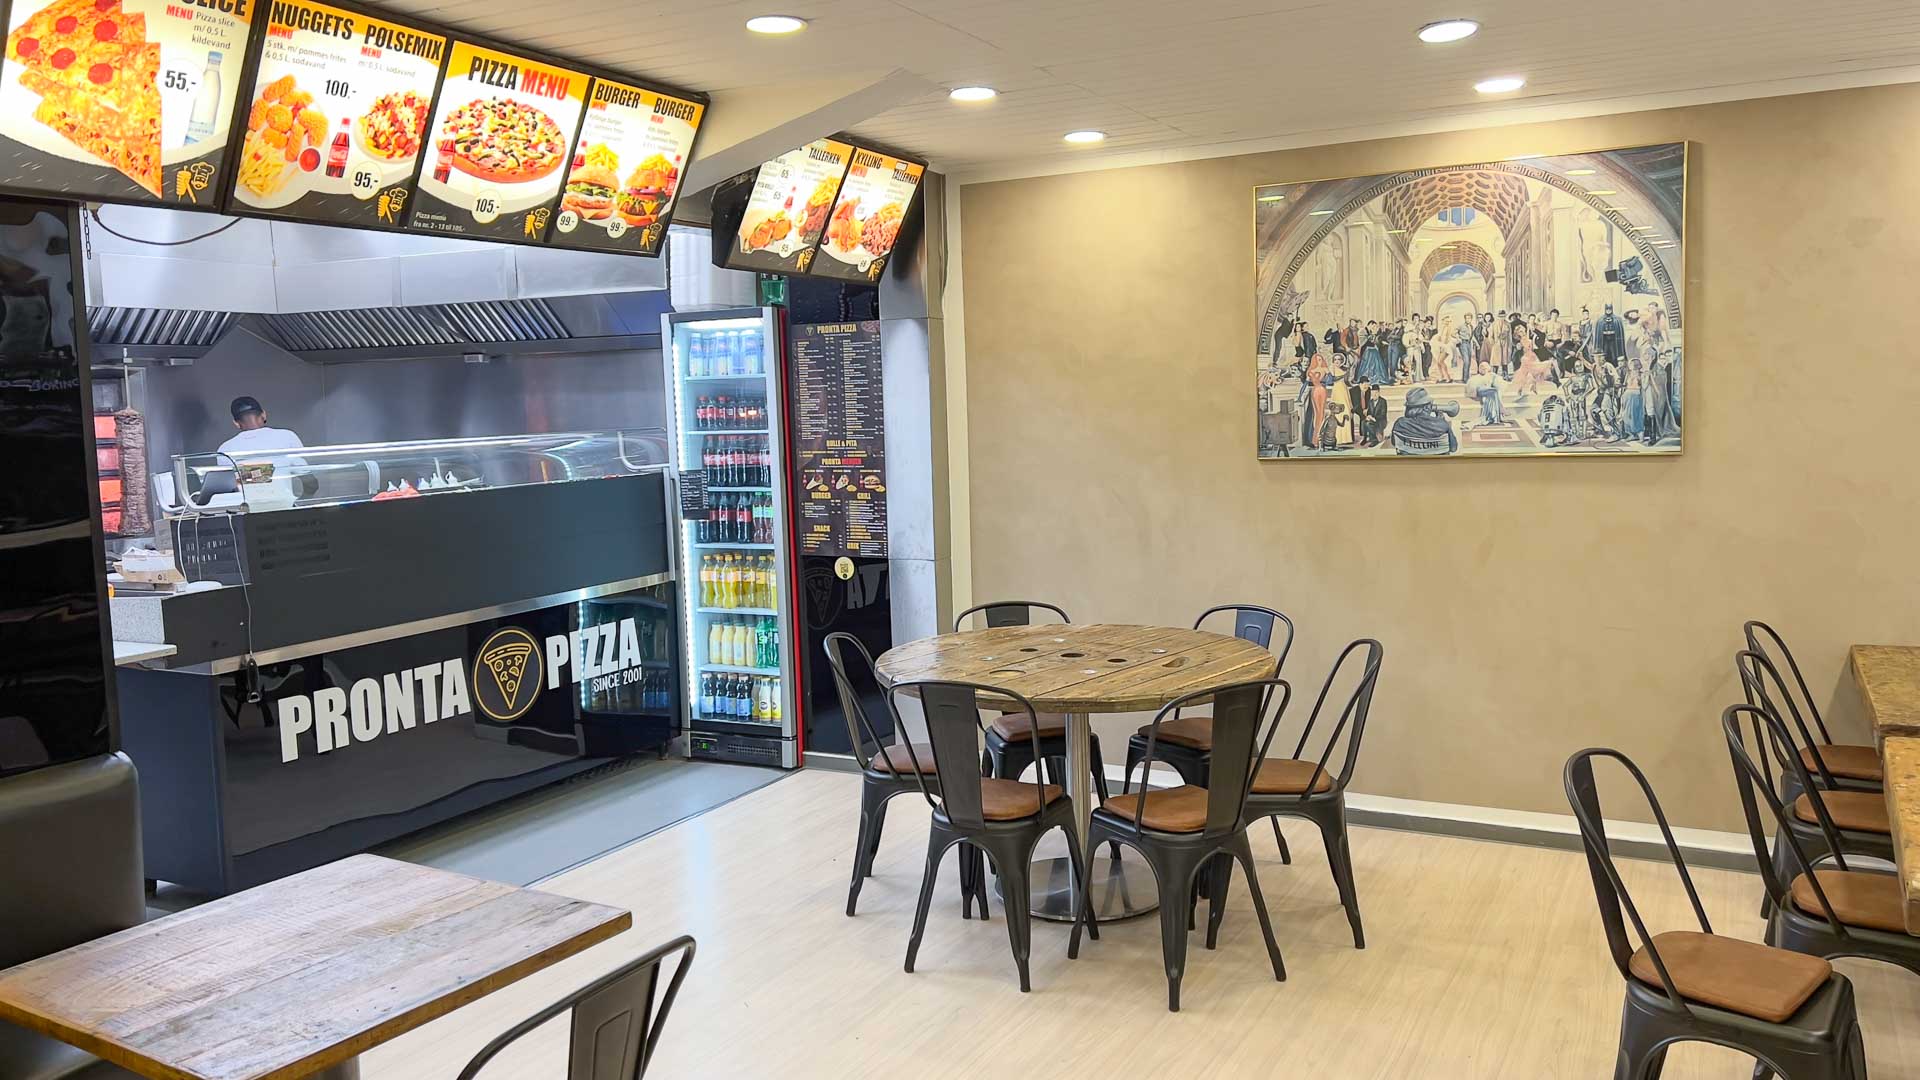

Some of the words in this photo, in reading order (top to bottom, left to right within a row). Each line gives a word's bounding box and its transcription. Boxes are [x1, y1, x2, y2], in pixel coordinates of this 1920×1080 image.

[166, 5, 194, 20] MENU
[196, 12, 216, 23] Pizza
[218, 18, 235, 27] slice
[271, 1, 354, 40] NUGGETS
[192, 34, 231, 50] kildevand
[268, 26, 294, 40] MENU
[364, 24, 443, 60] PØLSEMIX
[360, 46, 382, 59] MENU
[164, 70, 197, 92] 55,-
[468, 56, 518, 90] PIZZA
[520, 68, 570, 101] MENU
[325, 79, 357, 99] 100,-
[594, 83, 641, 109] BURGER
[653, 97, 696, 122] BURGER
[855, 152, 883, 170] KYLLING
[354, 170, 378, 190] 95,-
[415, 211, 430, 220] Pizza
[474, 198, 500, 214] 105,-
[816, 324, 840, 334] PRONTA
[840, 324, 857, 333] PIZZA
[592, 672, 621, 693] SINCE
[622, 666, 642, 686] 2001
[277, 657, 472, 764] PRONTA
[545, 616, 642, 690] PIZZA
